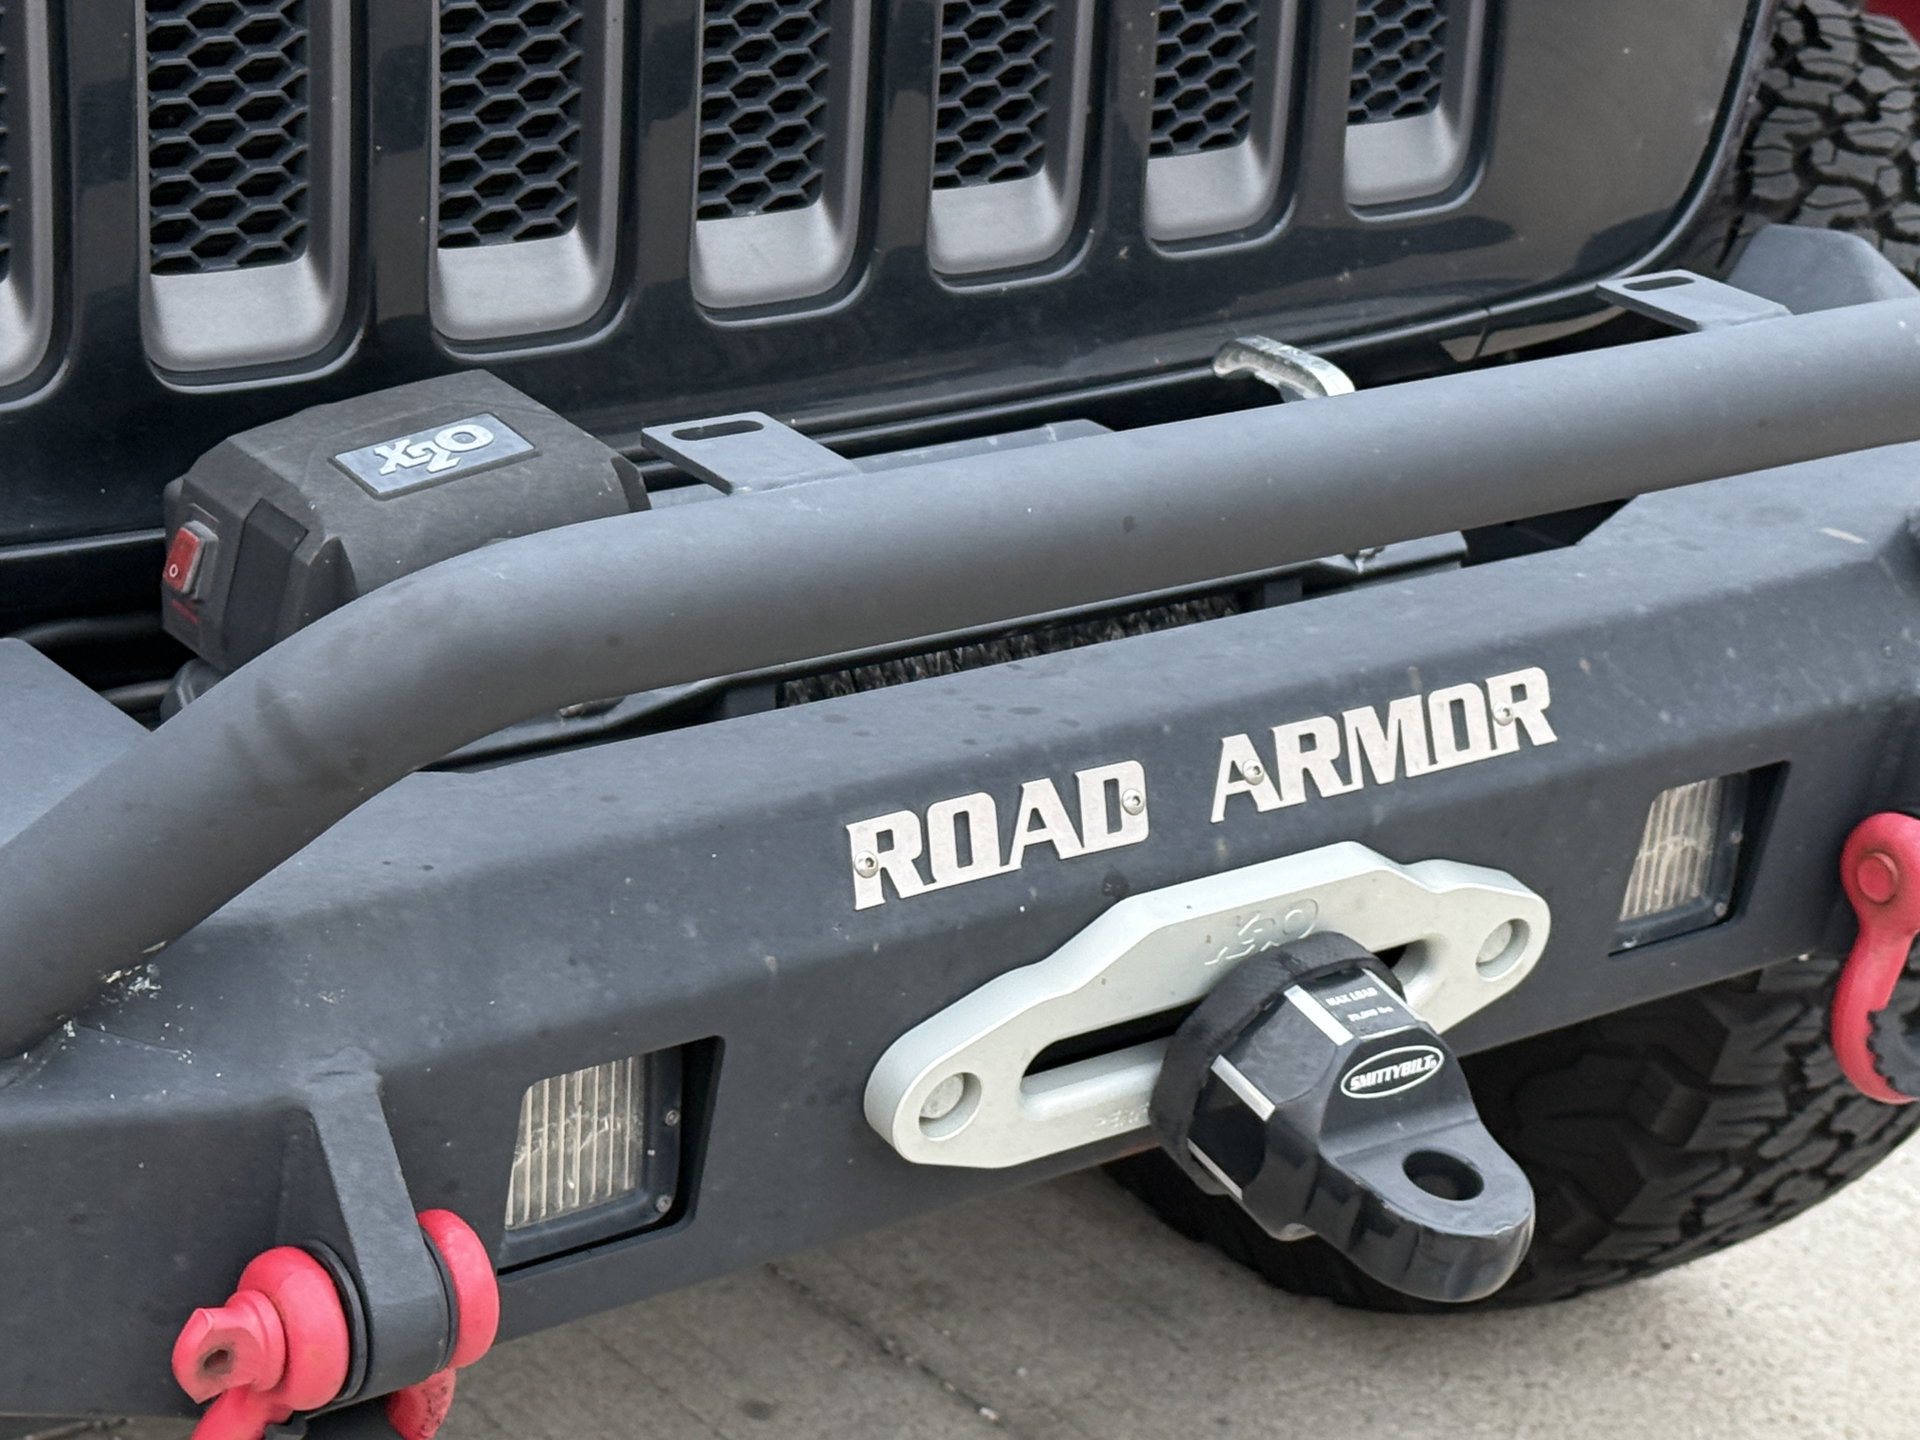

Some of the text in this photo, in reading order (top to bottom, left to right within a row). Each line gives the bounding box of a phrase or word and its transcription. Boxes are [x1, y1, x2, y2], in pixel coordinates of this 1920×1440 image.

[374, 424, 494, 476] X2O
[845, 666, 1559, 910] ROAD ARMOR
[1325, 986, 1378, 1006] MAX LOAD
[1350, 1054, 1436, 1091] SMITTYBILT
